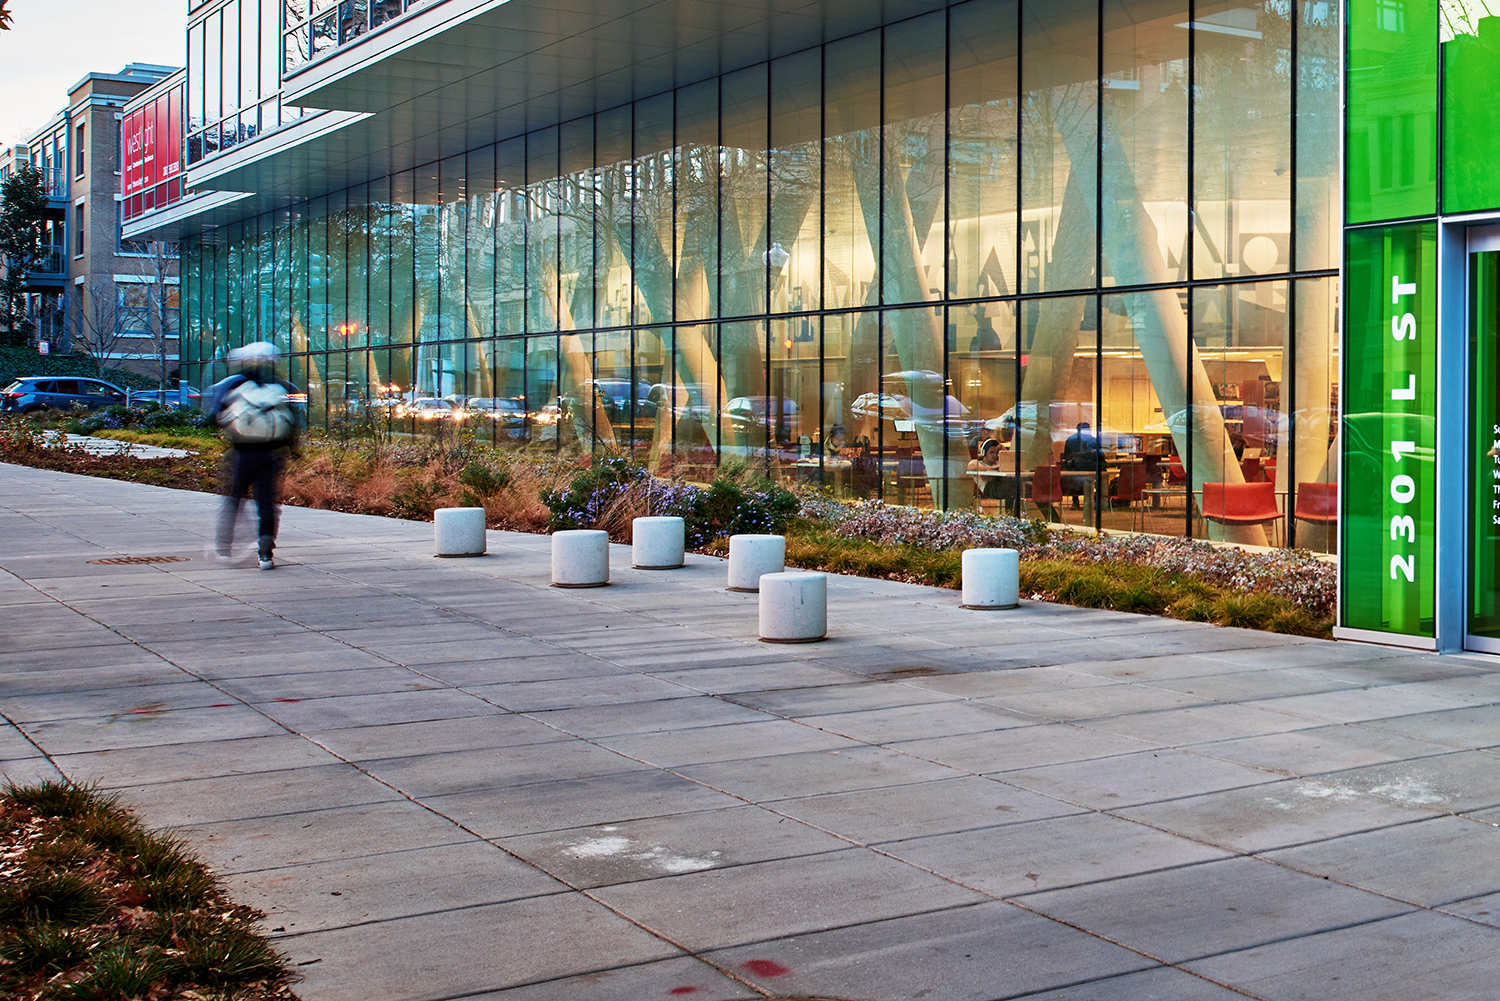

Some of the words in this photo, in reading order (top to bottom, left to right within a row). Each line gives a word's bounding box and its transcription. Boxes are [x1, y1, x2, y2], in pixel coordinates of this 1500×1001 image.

[1392, 276, 1416, 341] ST
[1392, 375, 1415, 399] L
[1391, 441, 1415, 582] 2301
